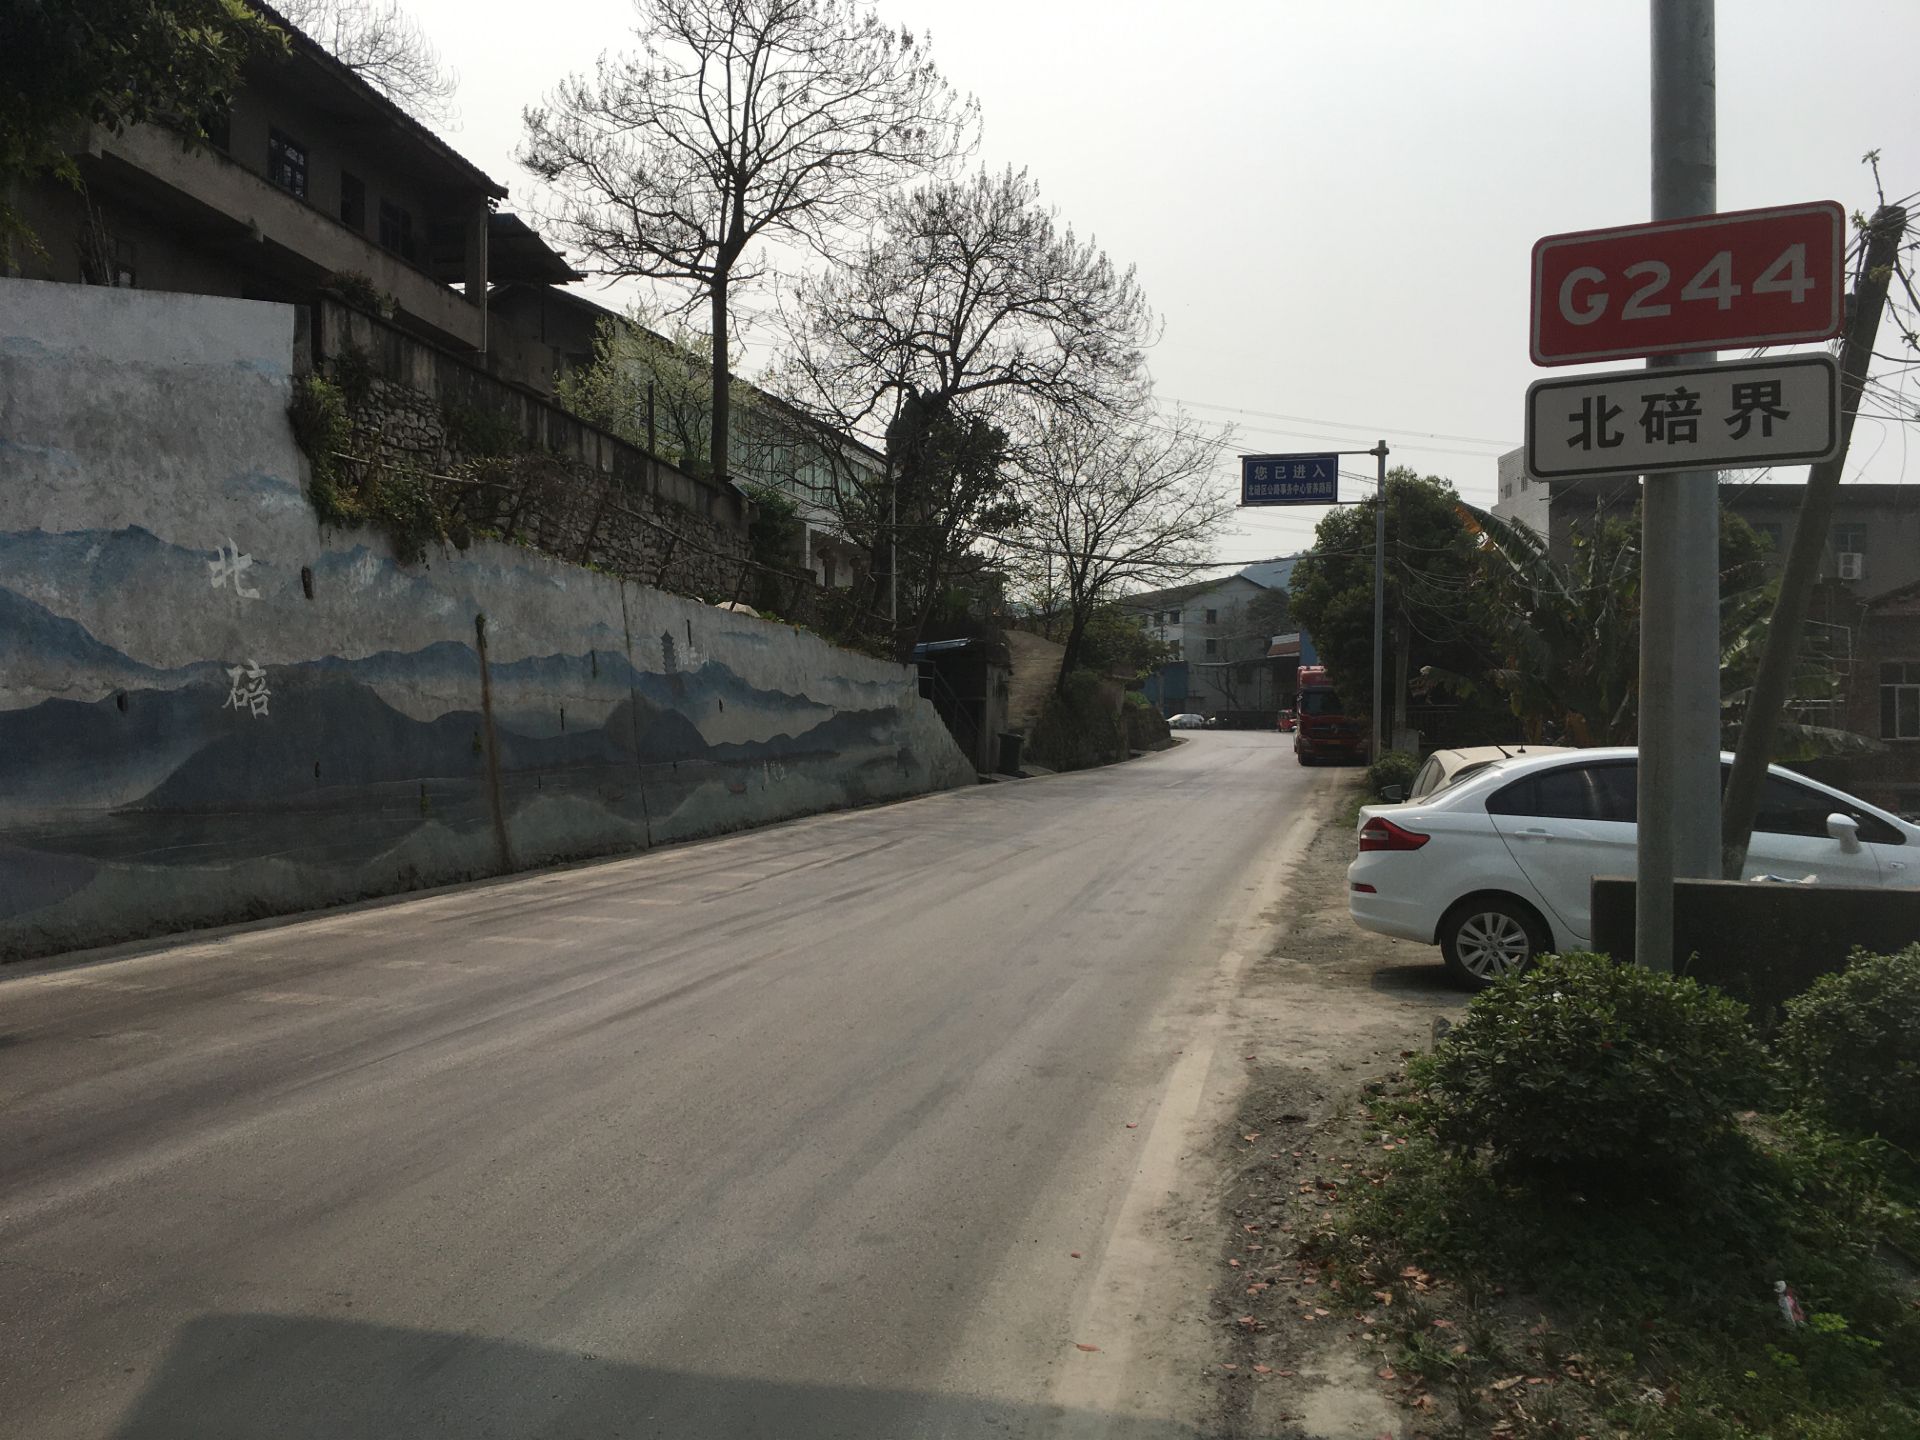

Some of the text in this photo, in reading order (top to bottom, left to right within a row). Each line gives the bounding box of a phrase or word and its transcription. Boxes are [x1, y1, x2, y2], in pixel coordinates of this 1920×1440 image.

[1558, 243, 1815, 326] G244
[1566, 379, 1790, 451] 北碚界
[1254, 464, 1326, 480] 您已进入
[208, 537, 271, 719] 北碚
